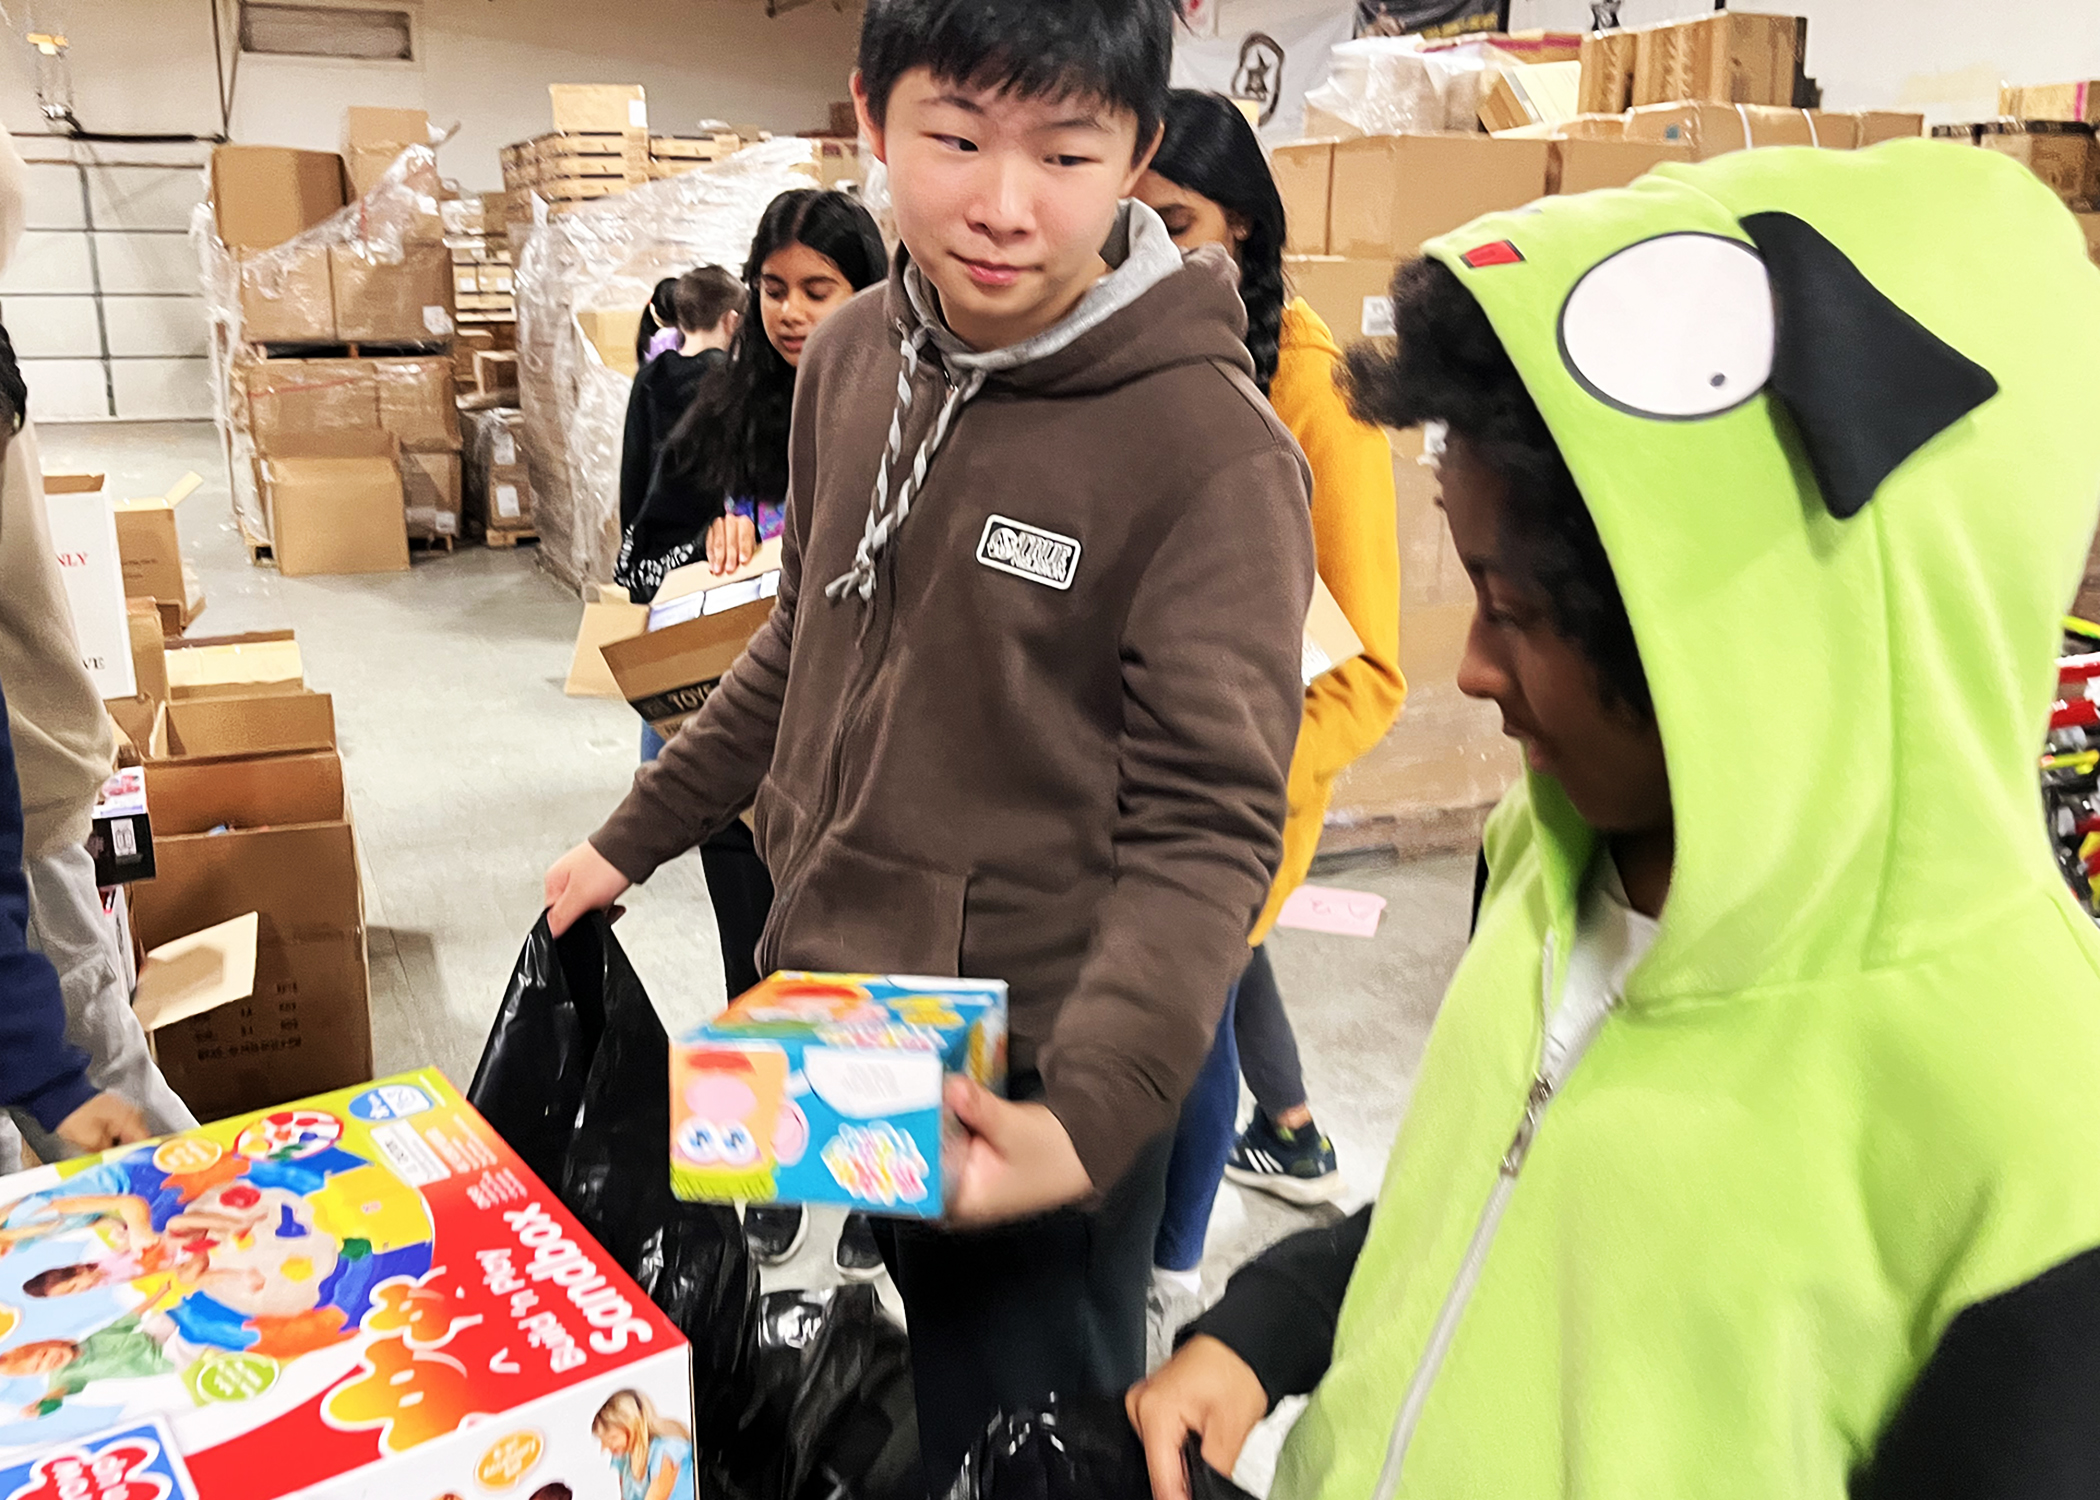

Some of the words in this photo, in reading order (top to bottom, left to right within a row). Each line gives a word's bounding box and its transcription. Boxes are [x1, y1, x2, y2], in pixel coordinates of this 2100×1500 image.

[55, 551, 89, 568] NLY
[82, 656, 105, 671] VE
[475, 1247, 526, 1296] Play
[503, 1202, 653, 1355] Sandbox
[518, 1310, 588, 1374] Build
